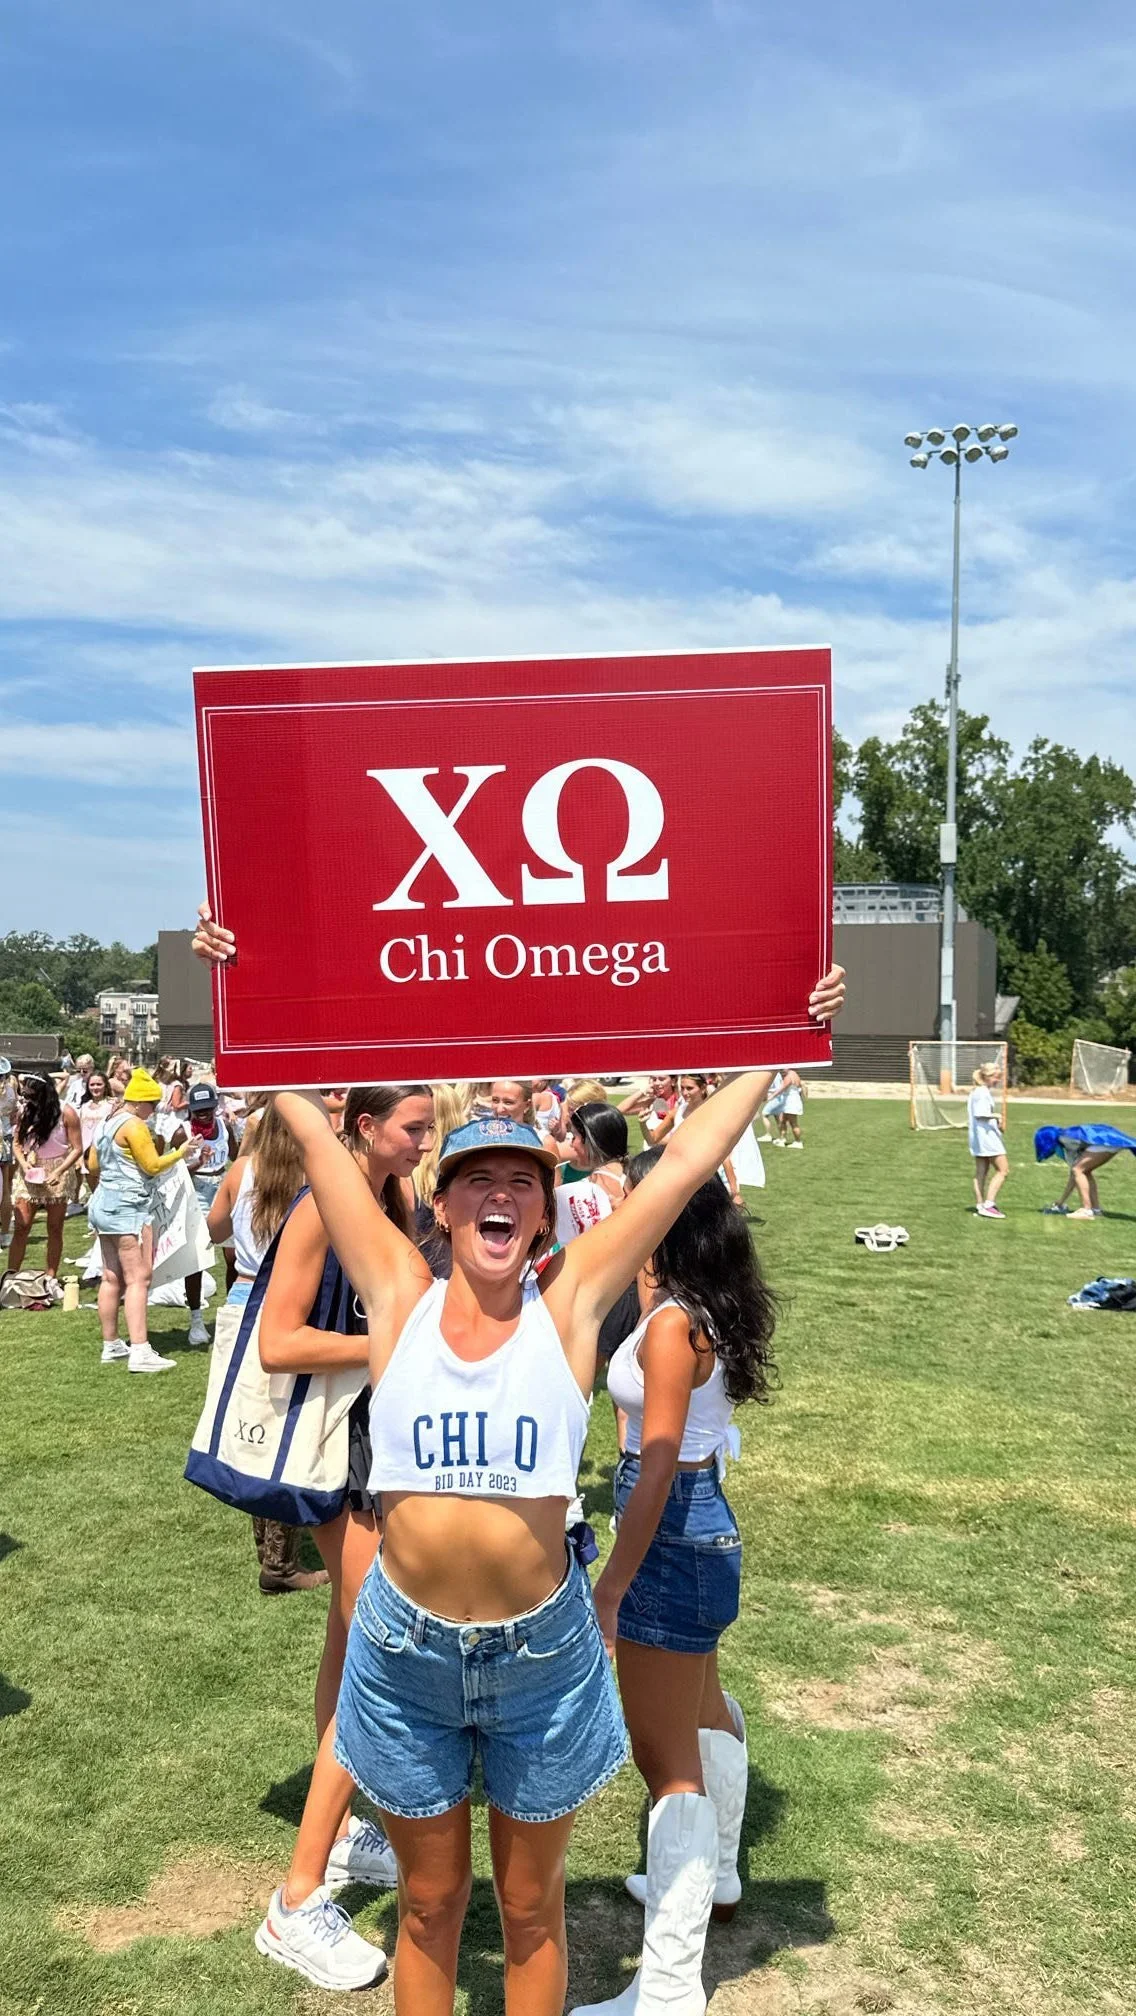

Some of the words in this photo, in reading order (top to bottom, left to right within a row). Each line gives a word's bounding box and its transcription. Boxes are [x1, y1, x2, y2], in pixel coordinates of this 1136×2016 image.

[379, 933, 470, 983] Chi
[485, 933, 670, 987] Omega
[413, 1411, 489, 1470] CHI
[514, 1414, 538, 1473] O
[435, 1473, 454, 1491] BID
[459, 1471, 484, 1488] DAY
[488, 1472, 517, 1493] 2023
